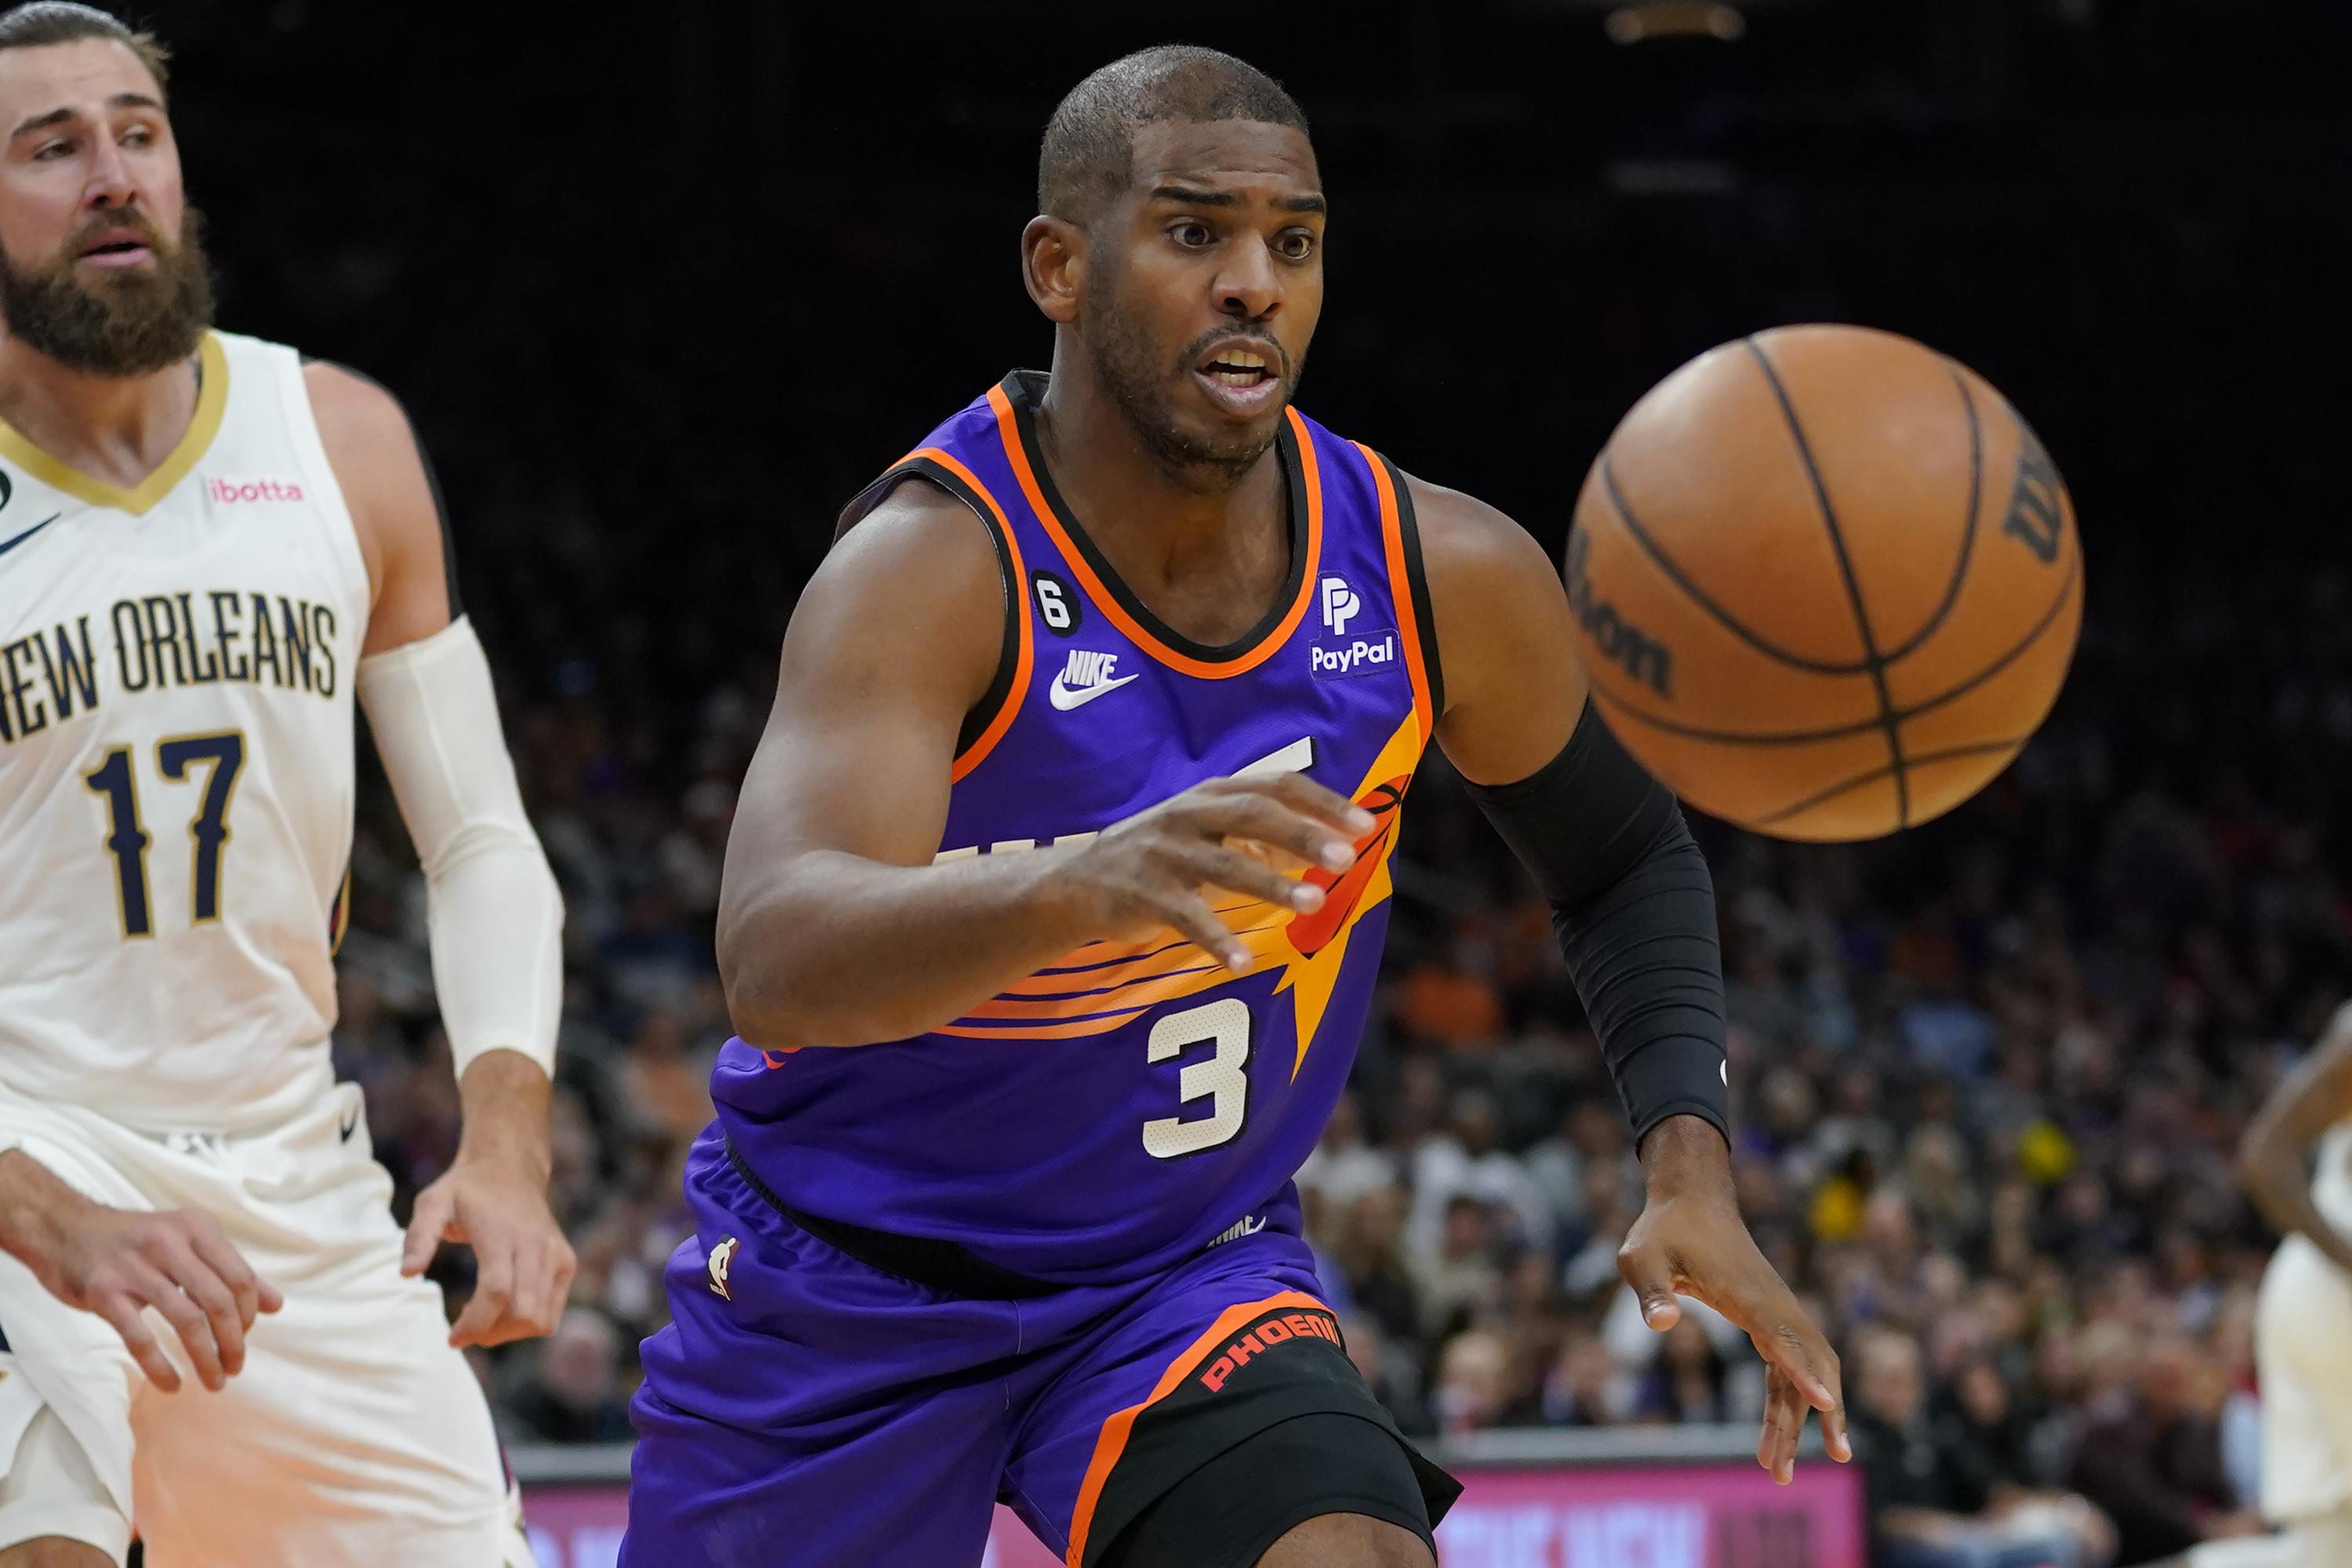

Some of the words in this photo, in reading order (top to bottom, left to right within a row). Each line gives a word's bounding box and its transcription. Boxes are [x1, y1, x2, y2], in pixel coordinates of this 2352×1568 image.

[209, 477, 304, 503] ibotta
[1036, 579, 1071, 628] 6
[111, 591, 336, 701] ORLEANS
[1062, 648, 1118, 688] NIKE
[1312, 636, 1393, 673] PayPal
[81, 728, 248, 941] 17
[1142, 997, 1254, 1160] 3
[1200, 1314, 1341, 1393] PHOENI
